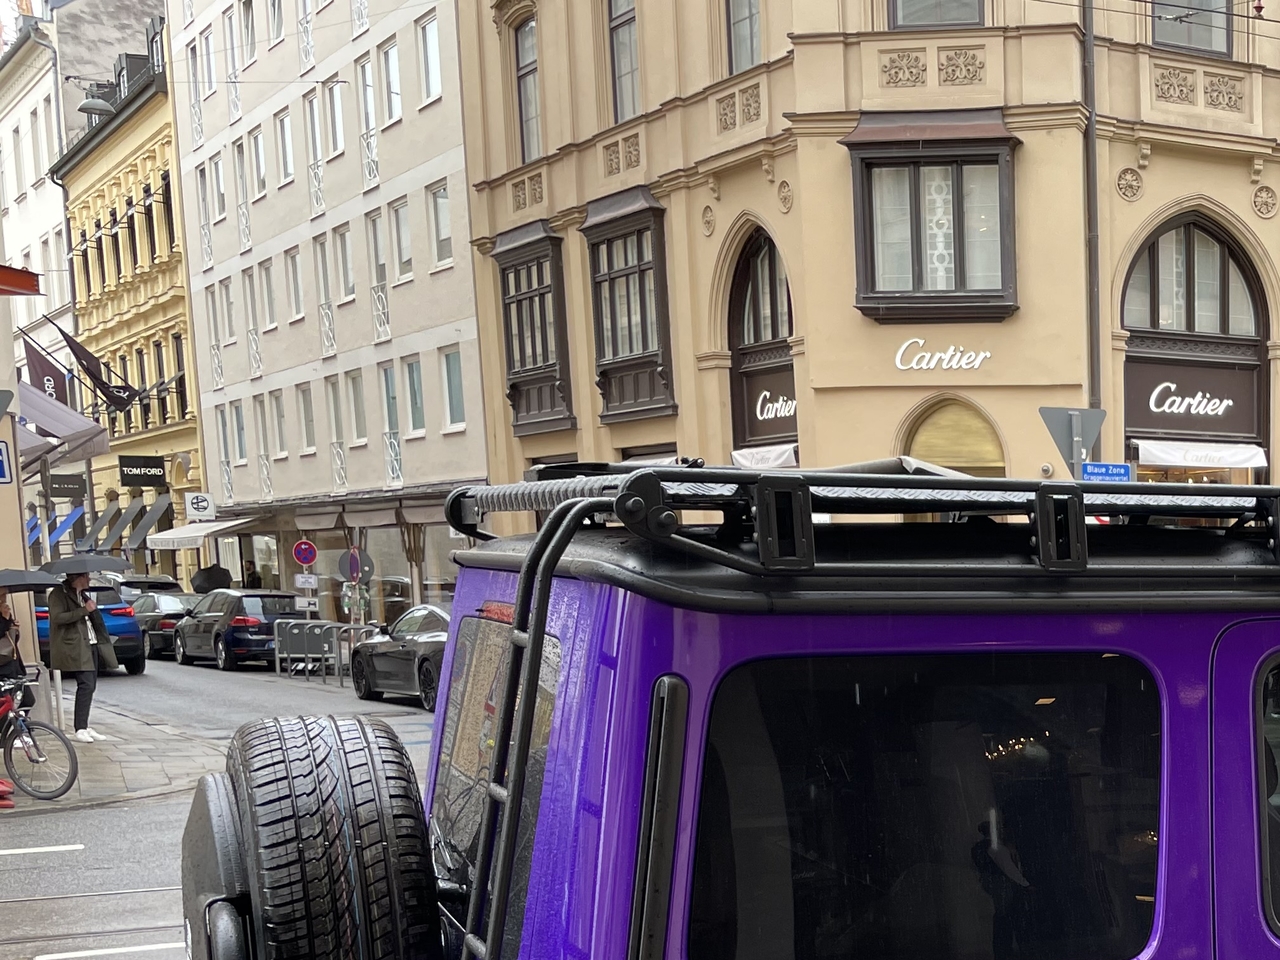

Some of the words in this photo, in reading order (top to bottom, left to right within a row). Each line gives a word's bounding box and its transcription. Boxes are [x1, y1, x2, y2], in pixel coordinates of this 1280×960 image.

[895, 338, 991, 370] Cartier
[756, 390, 797, 420] Cartier
[1149, 382, 1234, 415] Cartier
[1183, 449, 1223, 464] Cartier
[122, 467, 141, 475] TOM
[141, 467, 164, 475] FORD
[1087, 465, 1106, 474] Blaue
[1108, 466, 1125, 474] Zone
